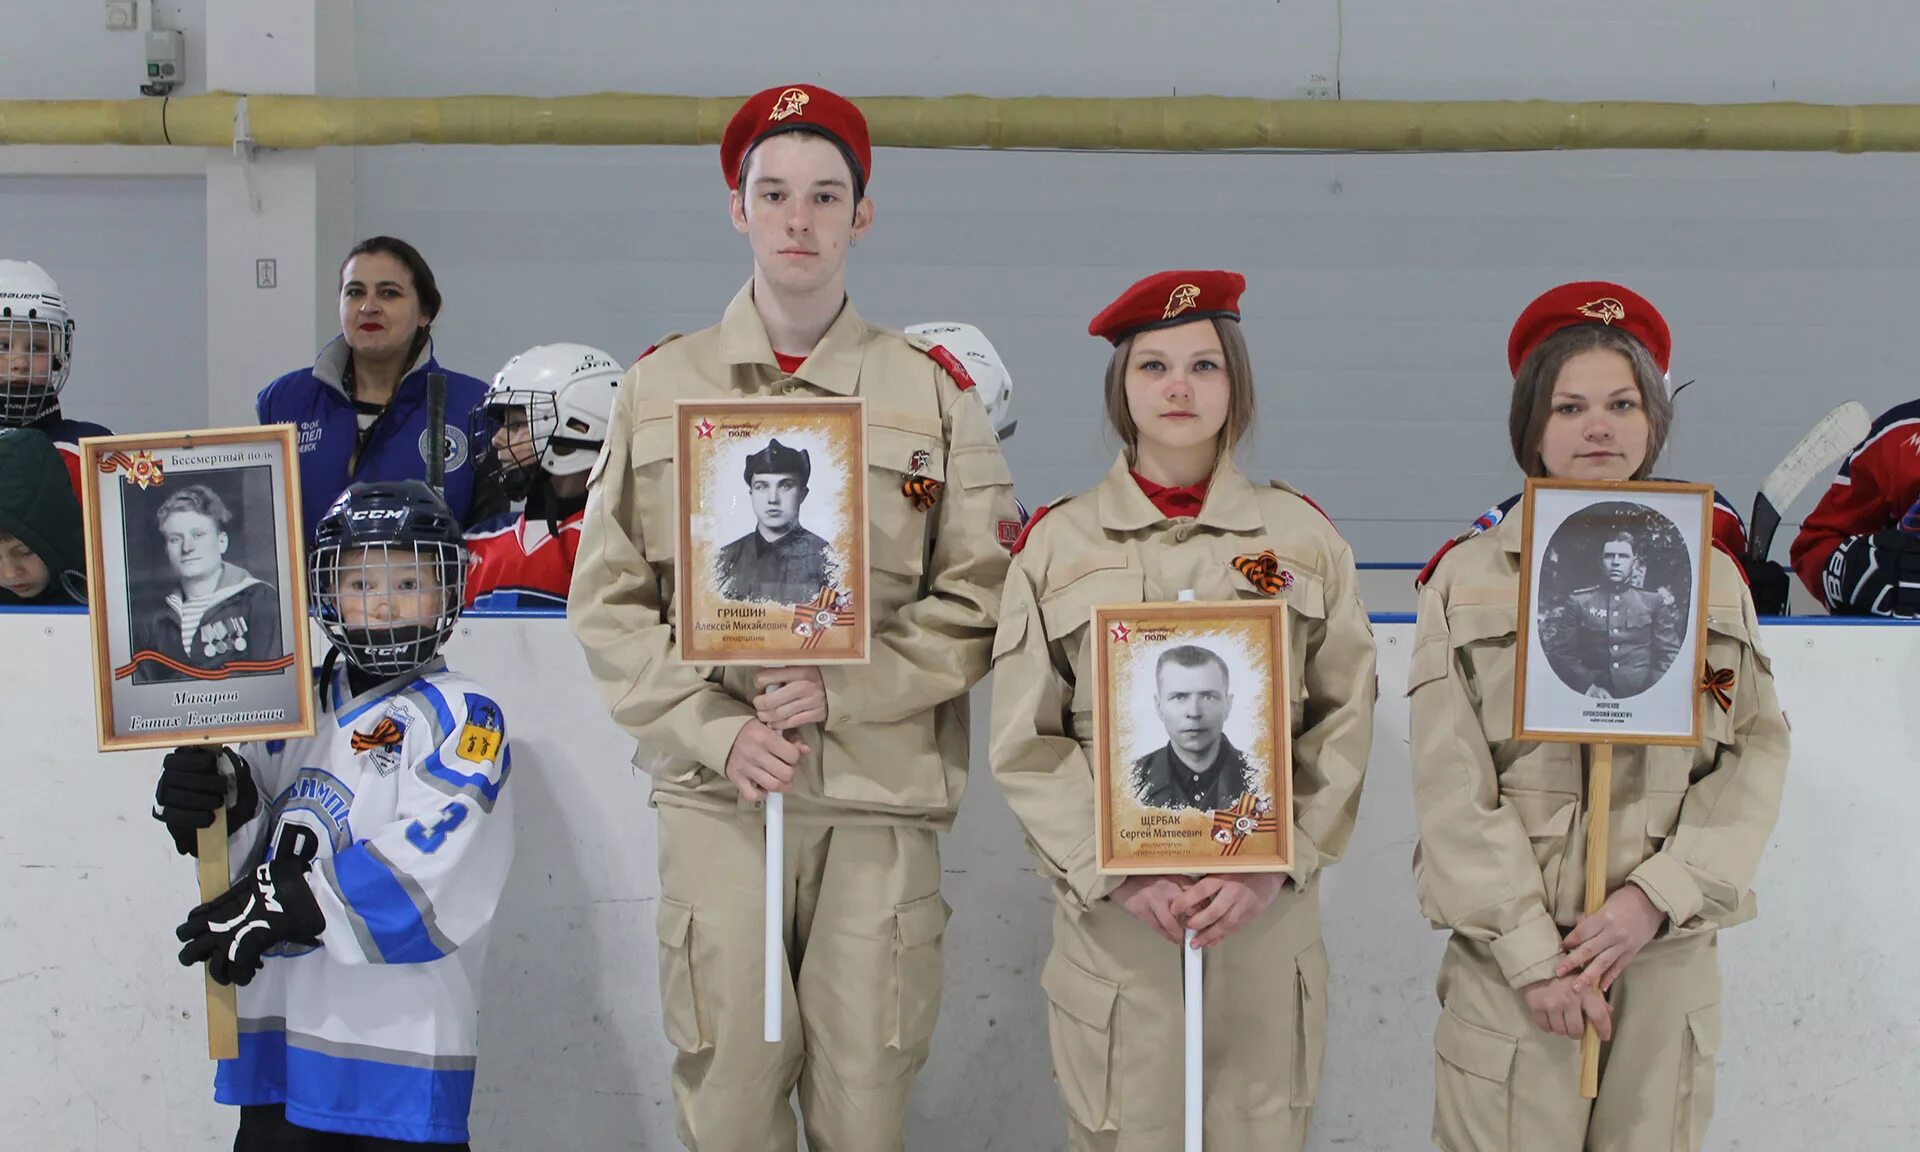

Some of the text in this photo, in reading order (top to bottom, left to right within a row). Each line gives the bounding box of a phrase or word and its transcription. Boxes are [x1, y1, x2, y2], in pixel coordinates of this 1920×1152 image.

[298, 428, 322, 443] ПЕЛ
[171, 452, 245, 466] Бессмертный
[352, 510, 404, 520] CCM
[717, 608, 767, 618] ГРИШИН
[695, 620, 788, 631] Алексей Михайлович
[172, 691, 239, 706] Макаров
[1140, 815, 1181, 826] ЩЕРБАК
[405, 801, 468, 854] 3
[1120, 828, 1202, 841] Сергей Матвеевич
